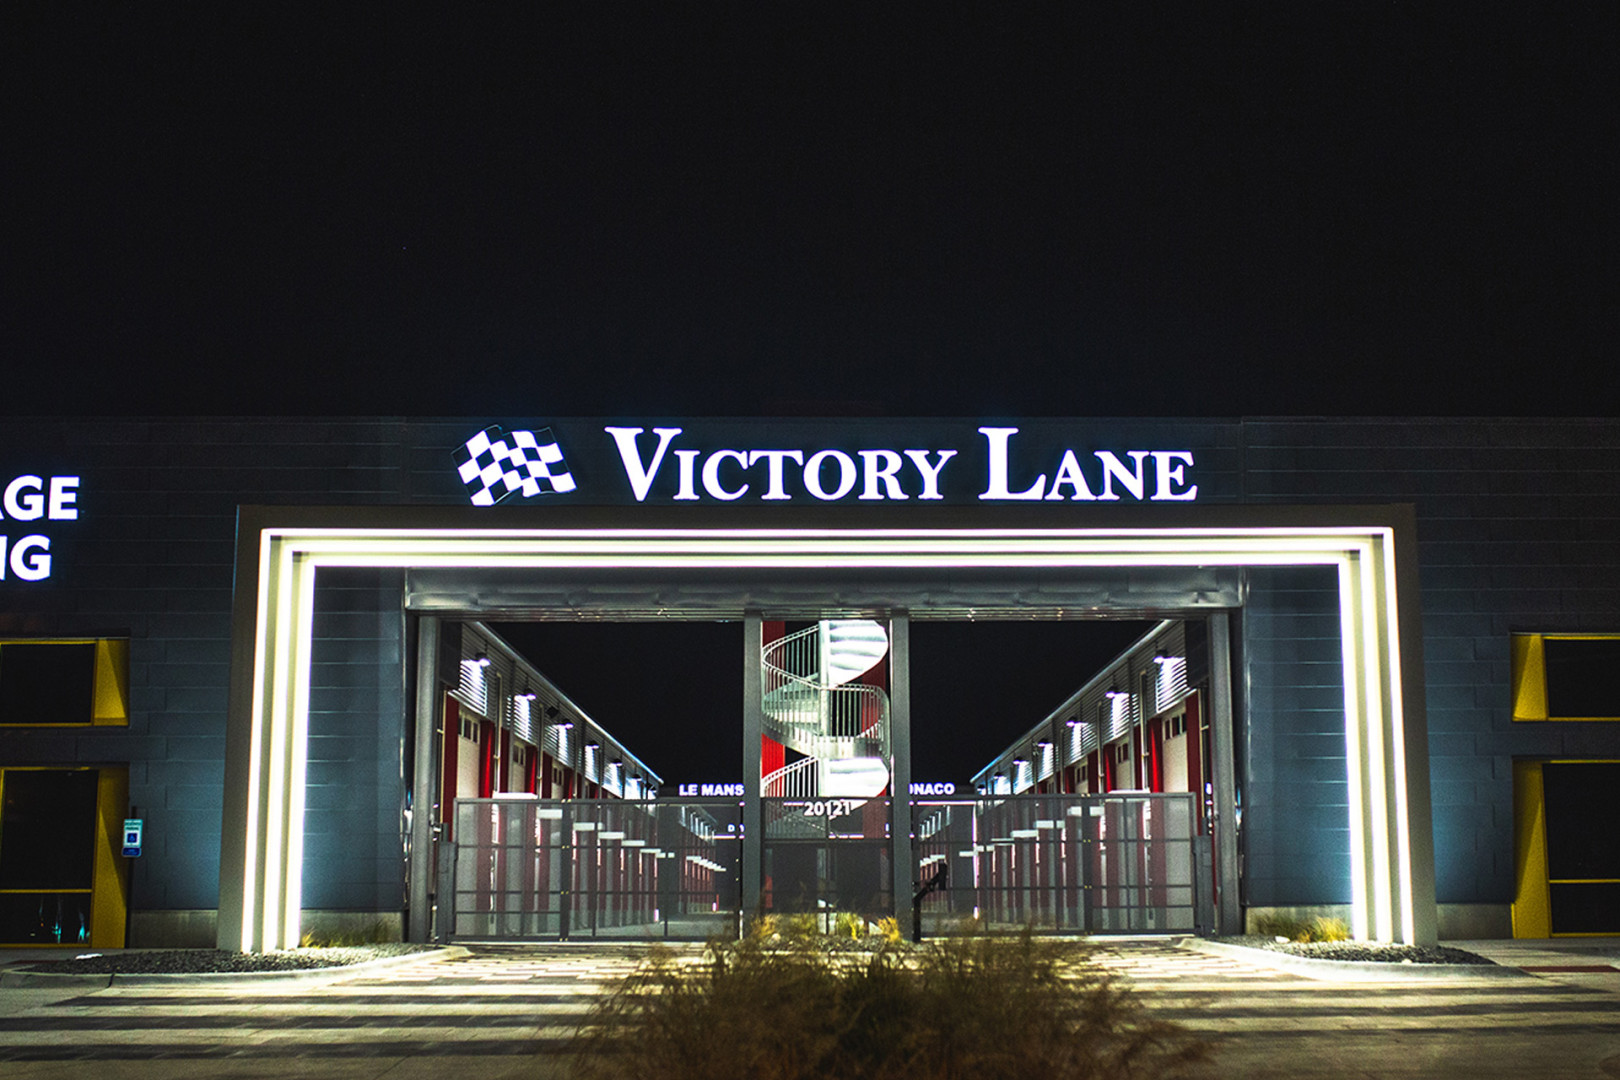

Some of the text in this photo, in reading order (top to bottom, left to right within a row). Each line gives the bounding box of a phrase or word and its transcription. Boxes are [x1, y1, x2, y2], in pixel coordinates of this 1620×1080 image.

[603, 425, 1199, 502] VICTORY LANE
[0, 474, 80, 522] GE
[679, 783, 745, 797] LE MANS
[803, 801, 850, 816] 20121
